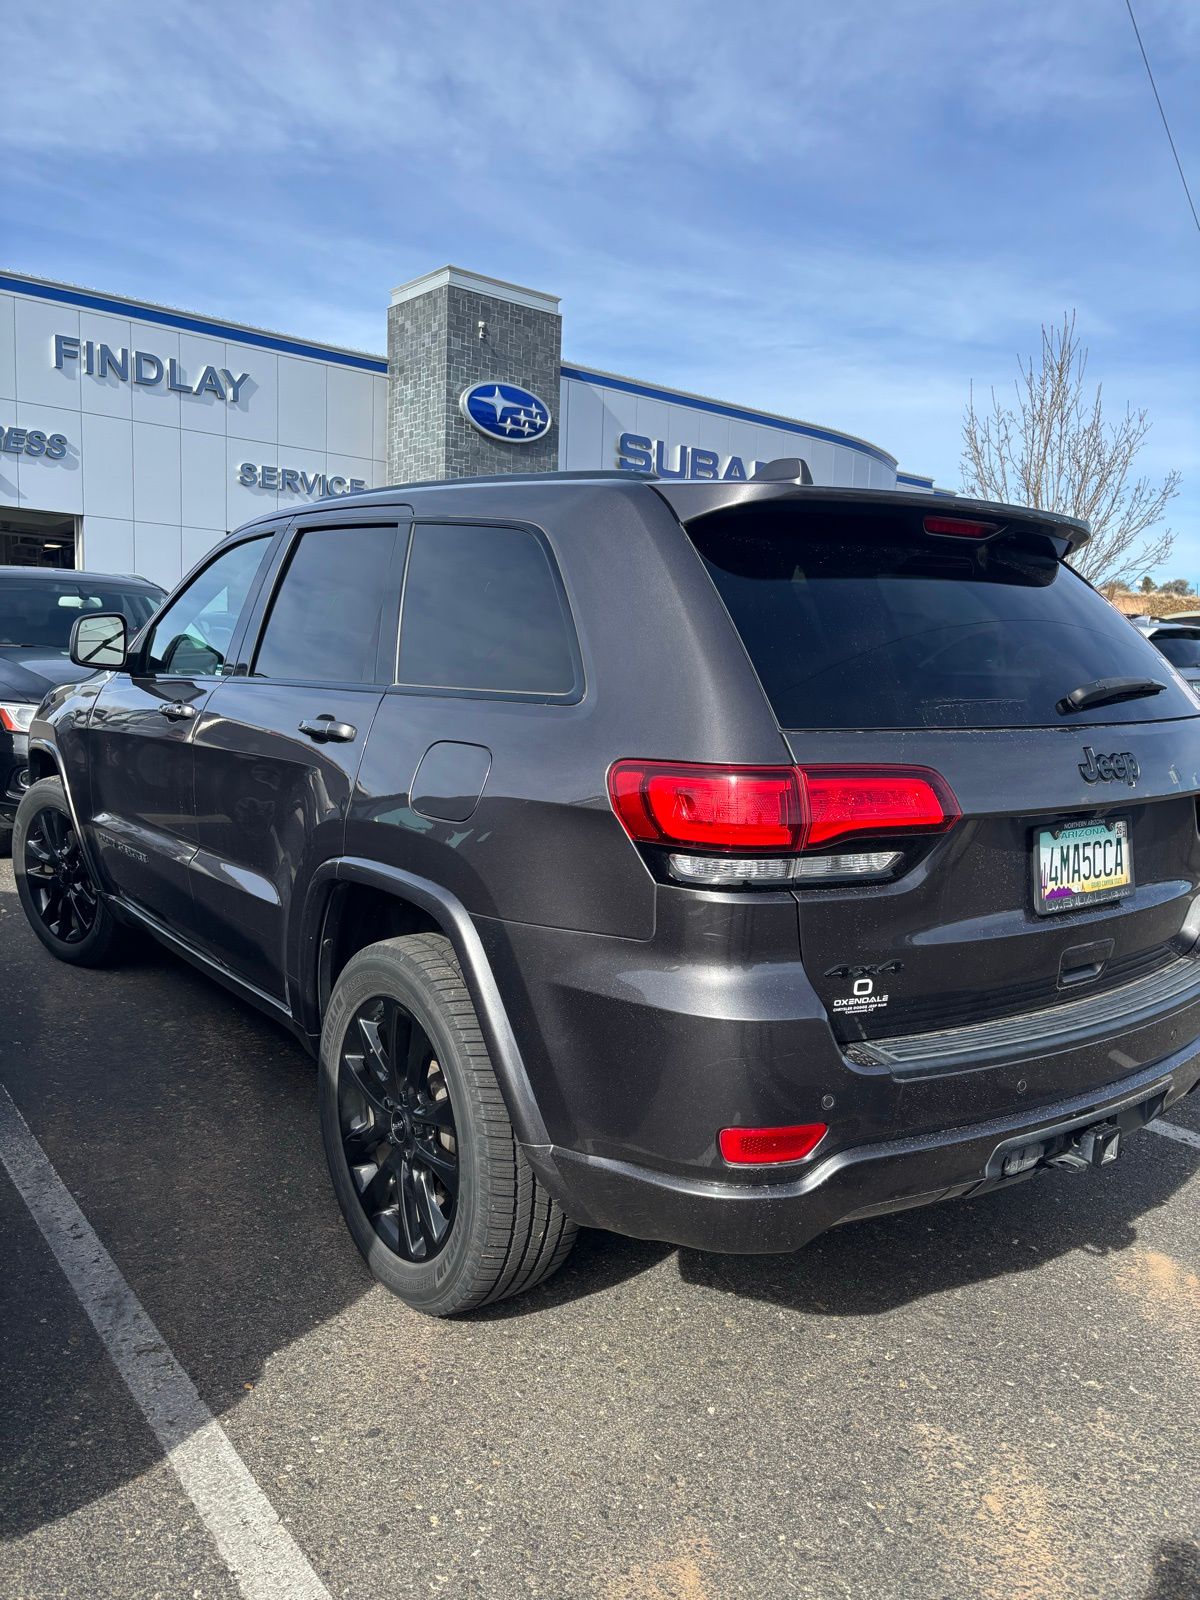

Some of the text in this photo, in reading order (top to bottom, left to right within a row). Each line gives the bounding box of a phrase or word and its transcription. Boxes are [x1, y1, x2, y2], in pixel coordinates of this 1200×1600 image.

[52, 334, 250, 402] FINDLAY
[0, 425, 68, 459] ESS
[239, 462, 366, 496] SERVICE
[1078, 746, 1140, 788] Jeep
[1061, 827, 1106, 839] ARIZONA
[1049, 837, 1124, 886] 4MA5CCA
[833, 995, 889, 1006] OXENDALE
